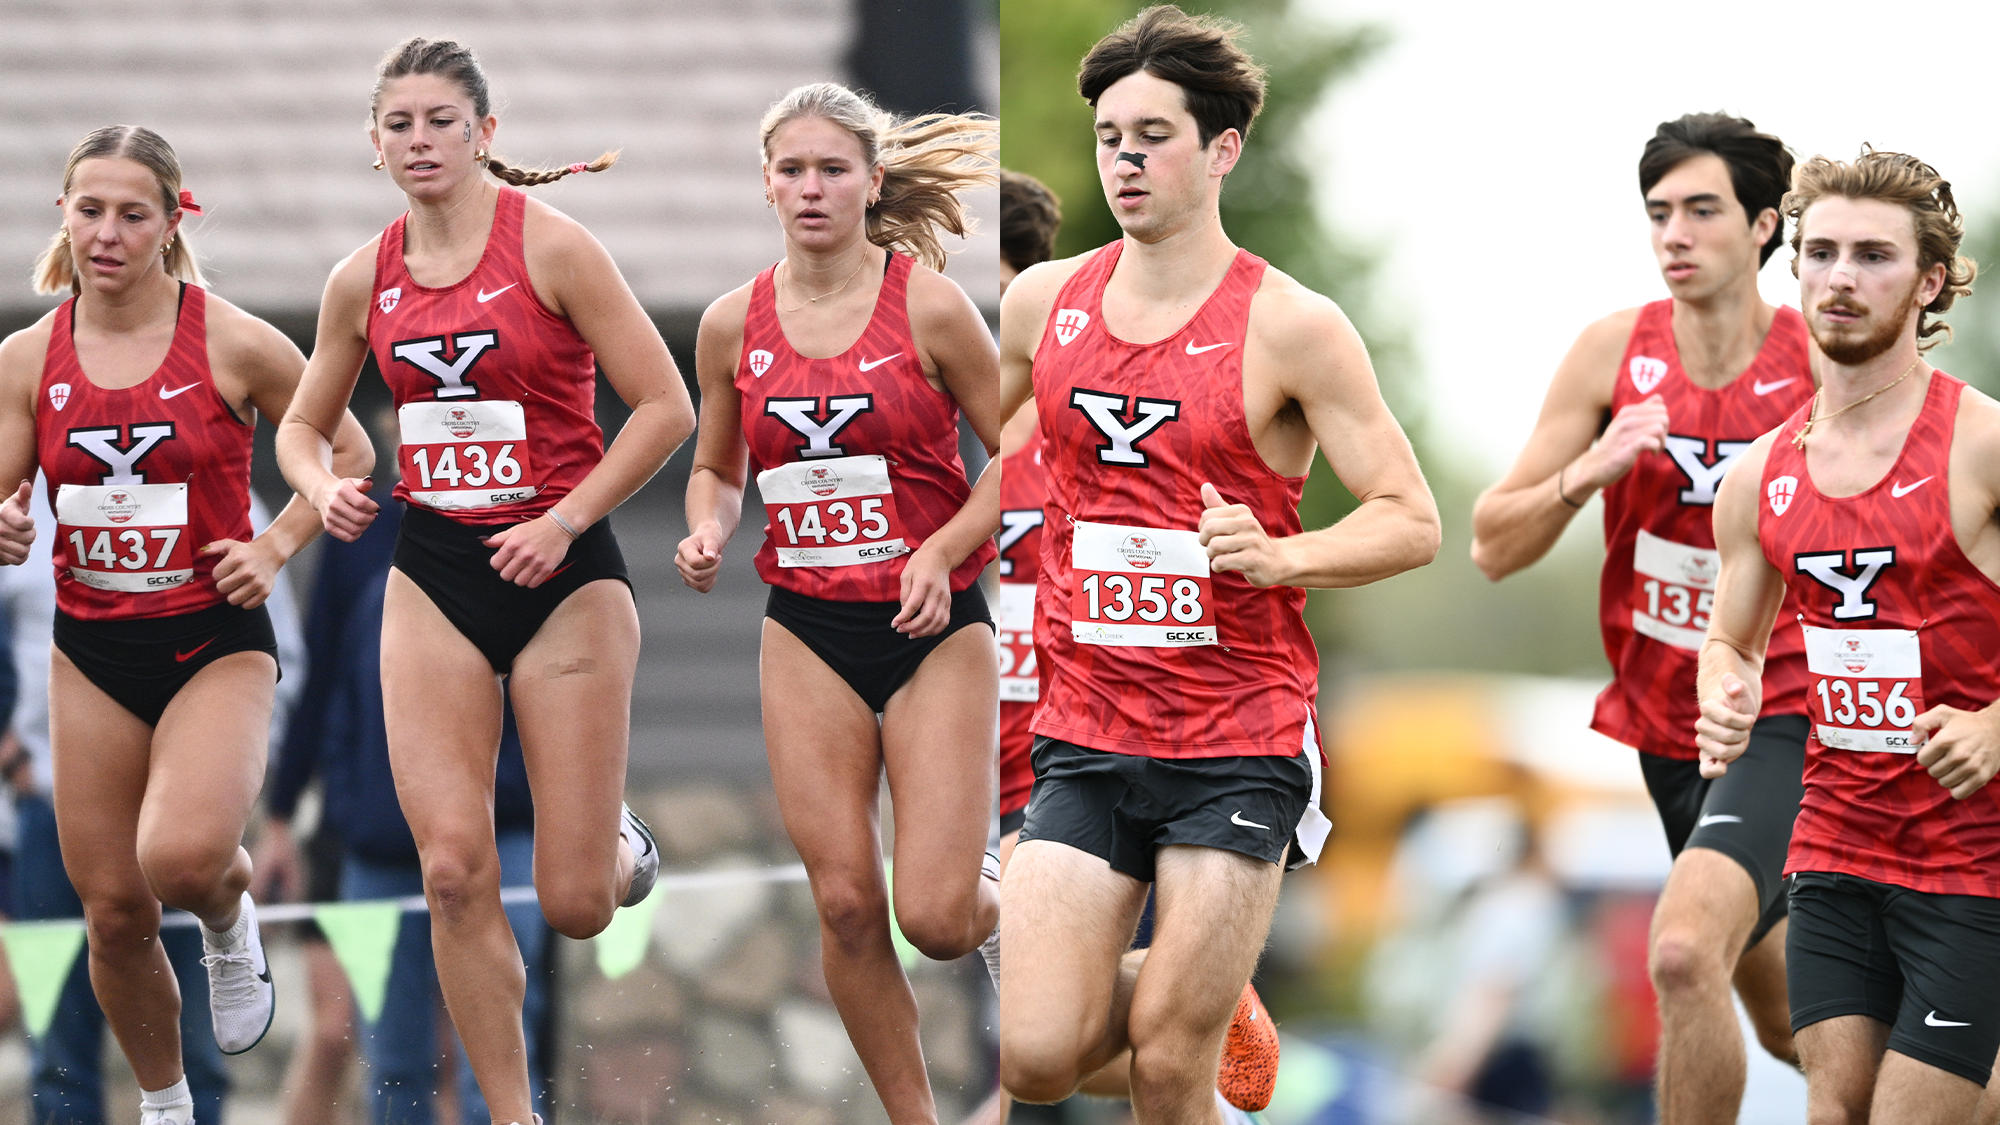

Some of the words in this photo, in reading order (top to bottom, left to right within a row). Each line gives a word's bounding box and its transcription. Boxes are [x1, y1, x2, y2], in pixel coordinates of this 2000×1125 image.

[391, 329, 500, 401] Y
[763, 393, 875, 461] Y
[1069, 387, 1182, 468] Y
[66, 421, 176, 486] Y
[412, 444, 522, 488] 1436
[490, 492, 525, 502] GCXC
[776, 498, 890, 545] 1435
[69, 528, 181, 569] 1437
[858, 545, 894, 557] GCXC
[147, 575, 182, 585] GCXC
[1082, 573, 1204, 624] 1358
[1794, 546, 1897, 622] Y
[1643, 580, 1716, 631] 135
[1000, 632, 1038, 677] 57
[1166, 632, 1205, 641] GCXC
[1816, 678, 1916, 728] 1356
[1885, 737, 1908, 746] GCX
